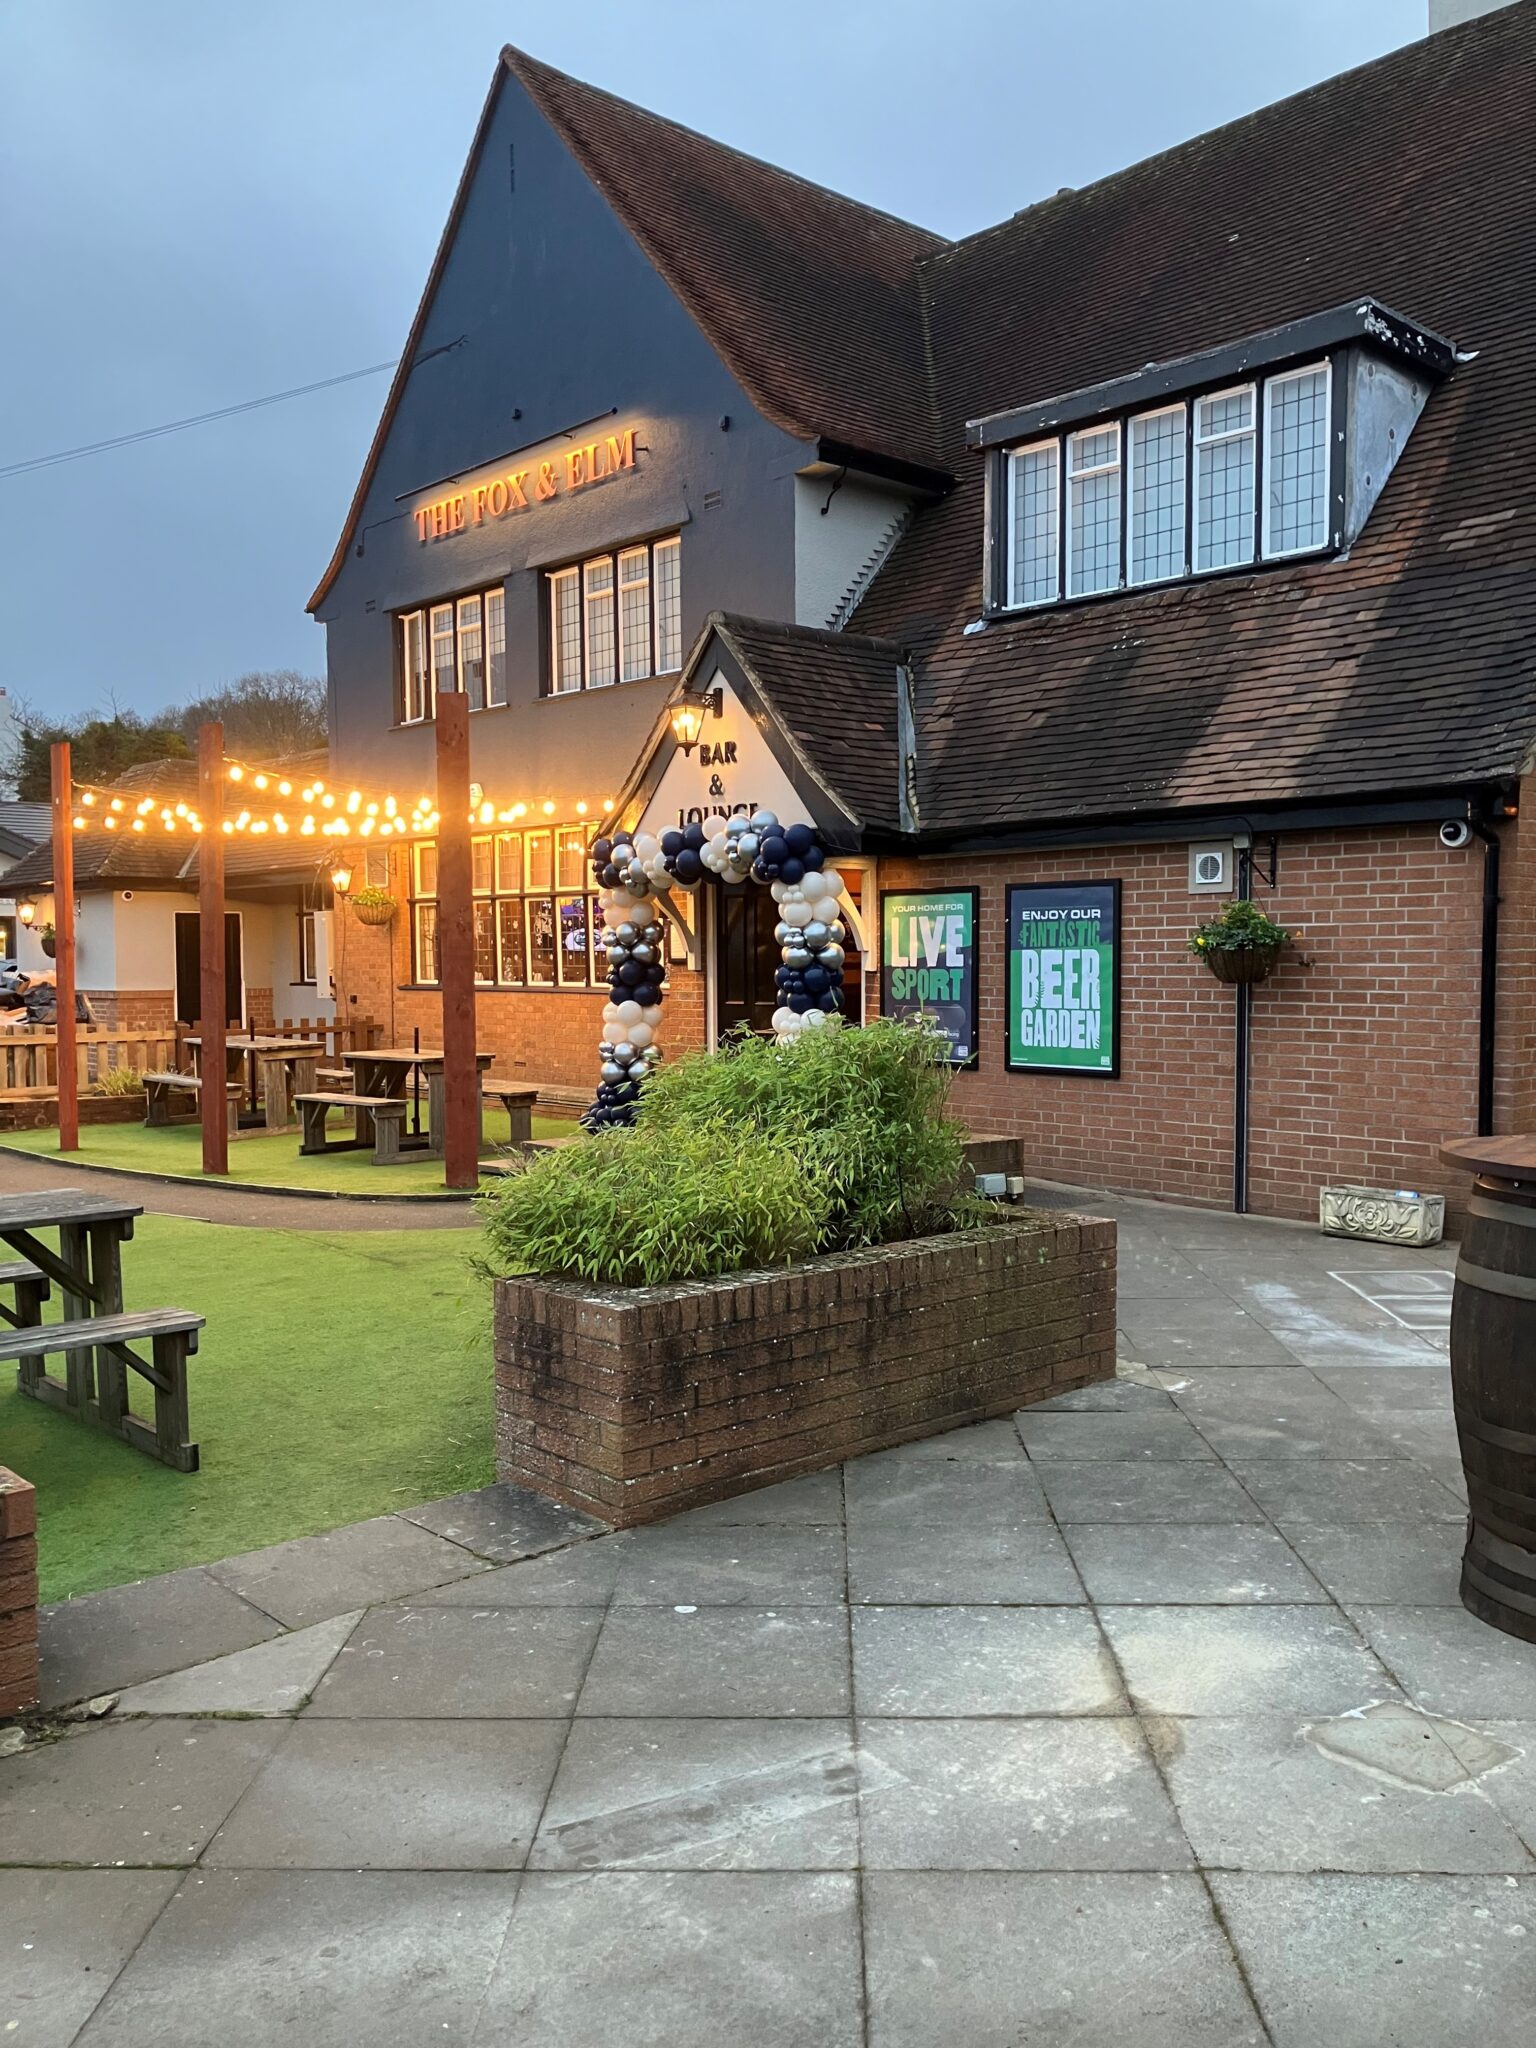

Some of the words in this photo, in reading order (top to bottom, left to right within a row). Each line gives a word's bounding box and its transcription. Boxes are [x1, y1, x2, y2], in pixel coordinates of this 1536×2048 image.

[414, 494, 466, 541] THE
[471, 470, 529, 524] FOX
[534, 461, 558, 501] &
[564, 428, 637, 490] ELM
[700, 741, 737, 766] BAR
[709, 773, 724, 796] &
[892, 905, 916, 913] YOUR
[917, 904, 944, 912] HOME
[945, 903, 964, 911] FOR
[1022, 909, 1068, 921] ENJOY
[1070, 909, 1101, 919] OUR
[891, 915, 964, 968] LIVE
[1020, 920, 1101, 947] FANTASTIC
[891, 968, 964, 1000] SPORT
[1021, 948, 1101, 1010] BEER
[1021, 1009, 1100, 1049] GARDEN
